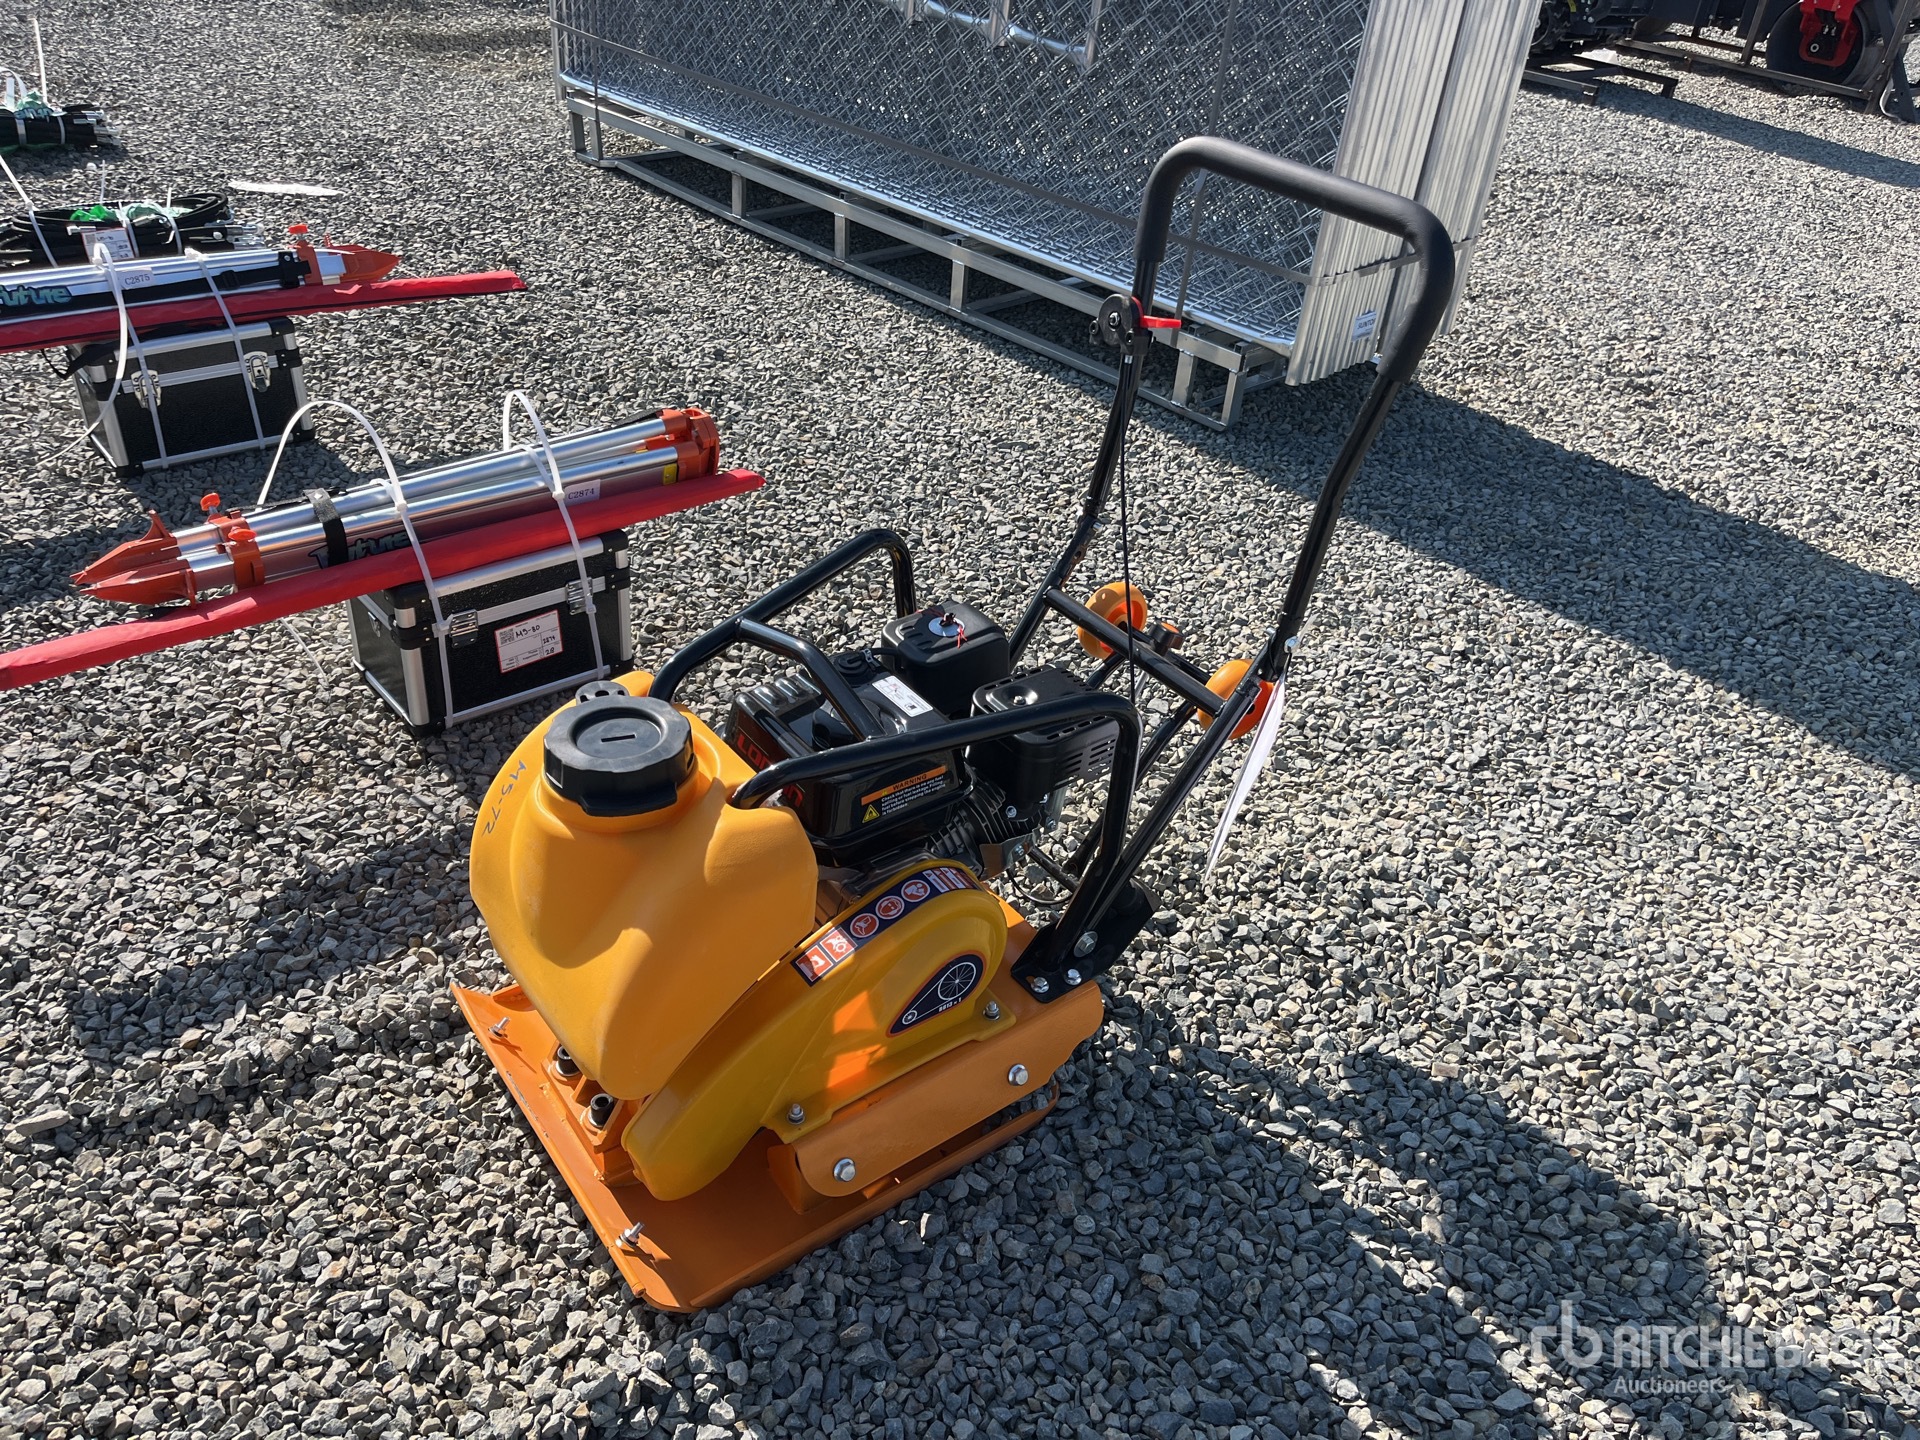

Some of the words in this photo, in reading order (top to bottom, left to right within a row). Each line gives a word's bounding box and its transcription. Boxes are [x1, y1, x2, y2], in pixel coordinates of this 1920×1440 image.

[124, 273, 151, 286] C2875
[0, 284, 72, 307] uture
[568, 488, 595, 500] C2874
[893, 774, 927, 791] WARNING
[882, 794, 894, 802] Check
